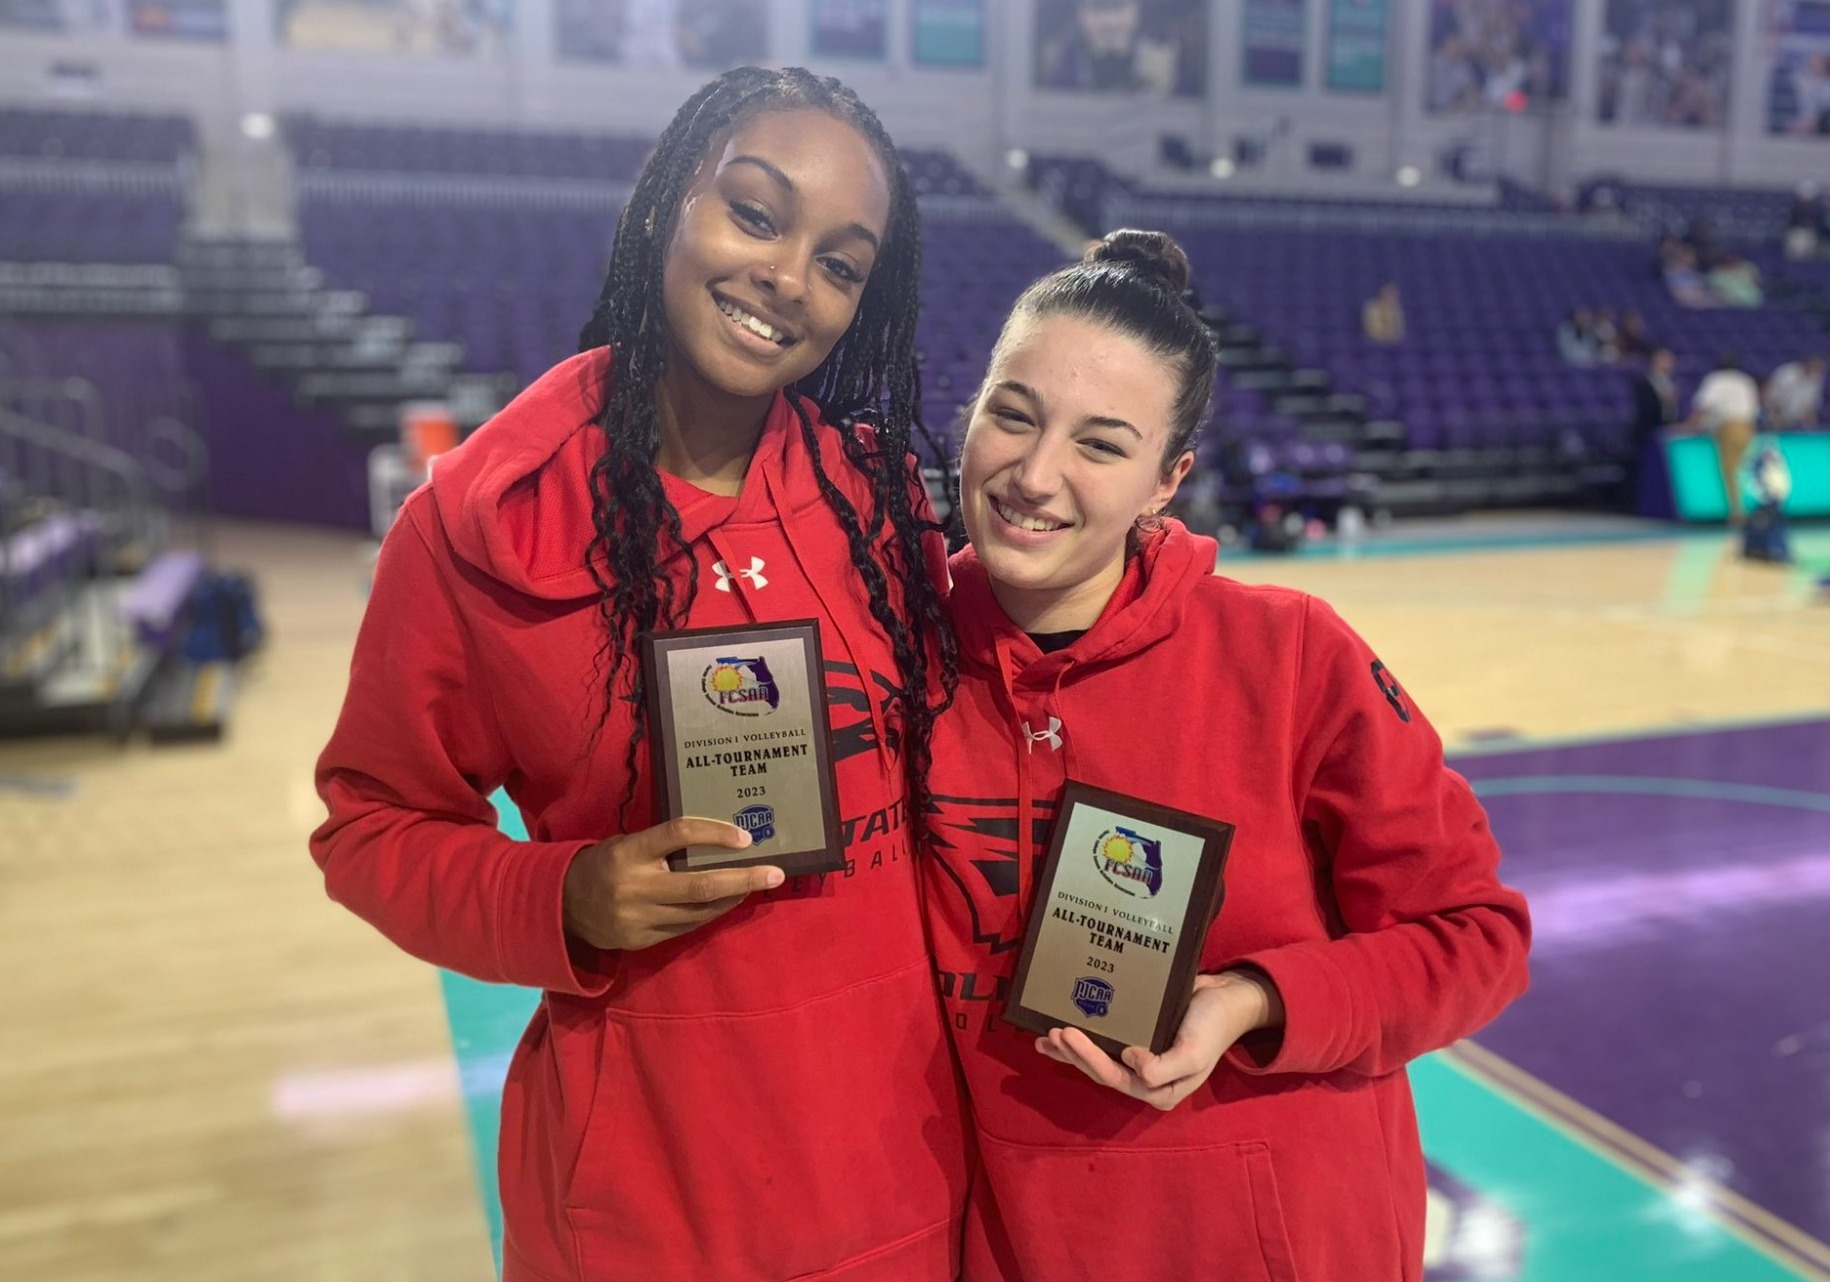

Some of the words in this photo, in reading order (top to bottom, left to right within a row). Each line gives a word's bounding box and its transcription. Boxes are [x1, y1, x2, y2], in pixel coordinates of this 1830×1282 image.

[719, 686, 768, 705] FCSAA
[684, 736, 732, 749] DIVISION
[743, 728, 807, 742] VOLLEYBALL
[686, 744, 808, 768] ALL-TOURNAMENT
[730, 763, 767, 777] TEAM
[737, 786, 766, 798] 2023
[1104, 859, 1153, 885] FCSAA
[1057, 891, 1103, 912] DIVISION
[1052, 907, 1171, 954] ALL-TOURNAMENT
[1089, 932, 1125, 954] TEAM
[1086, 956, 1115, 973] 2023
[1073, 981, 1112, 1001] NJCAA
